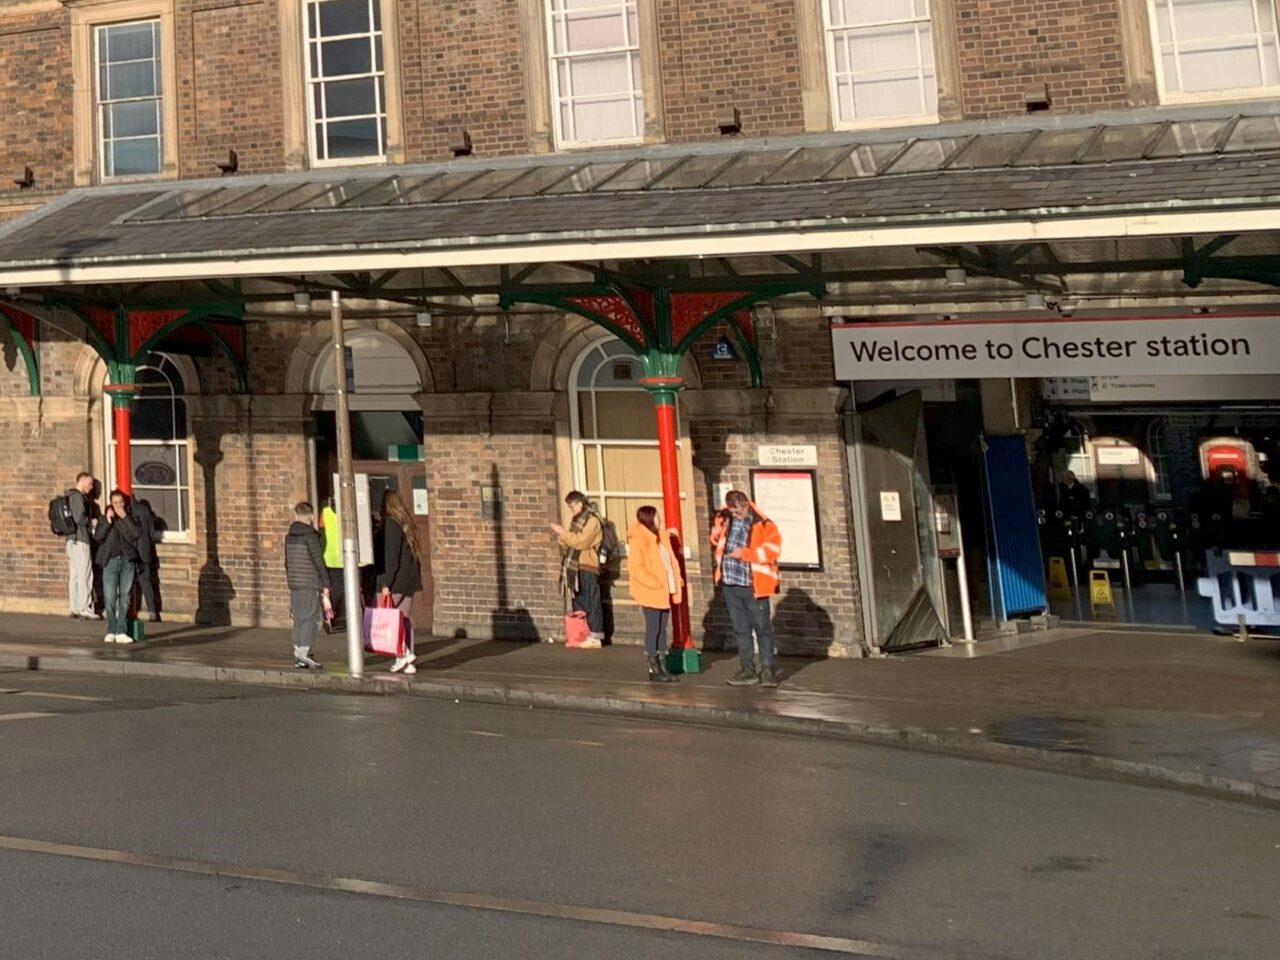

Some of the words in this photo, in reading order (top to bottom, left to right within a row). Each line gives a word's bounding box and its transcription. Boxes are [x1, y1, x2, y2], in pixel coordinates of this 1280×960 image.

[849, 339, 977, 363] Welcome
[985, 339, 1013, 360] to
[1022, 337, 1137, 360] Chester
[1146, 333, 1252, 358] station
[770, 447, 804, 455] Chester
[771, 456, 805, 464] Station
